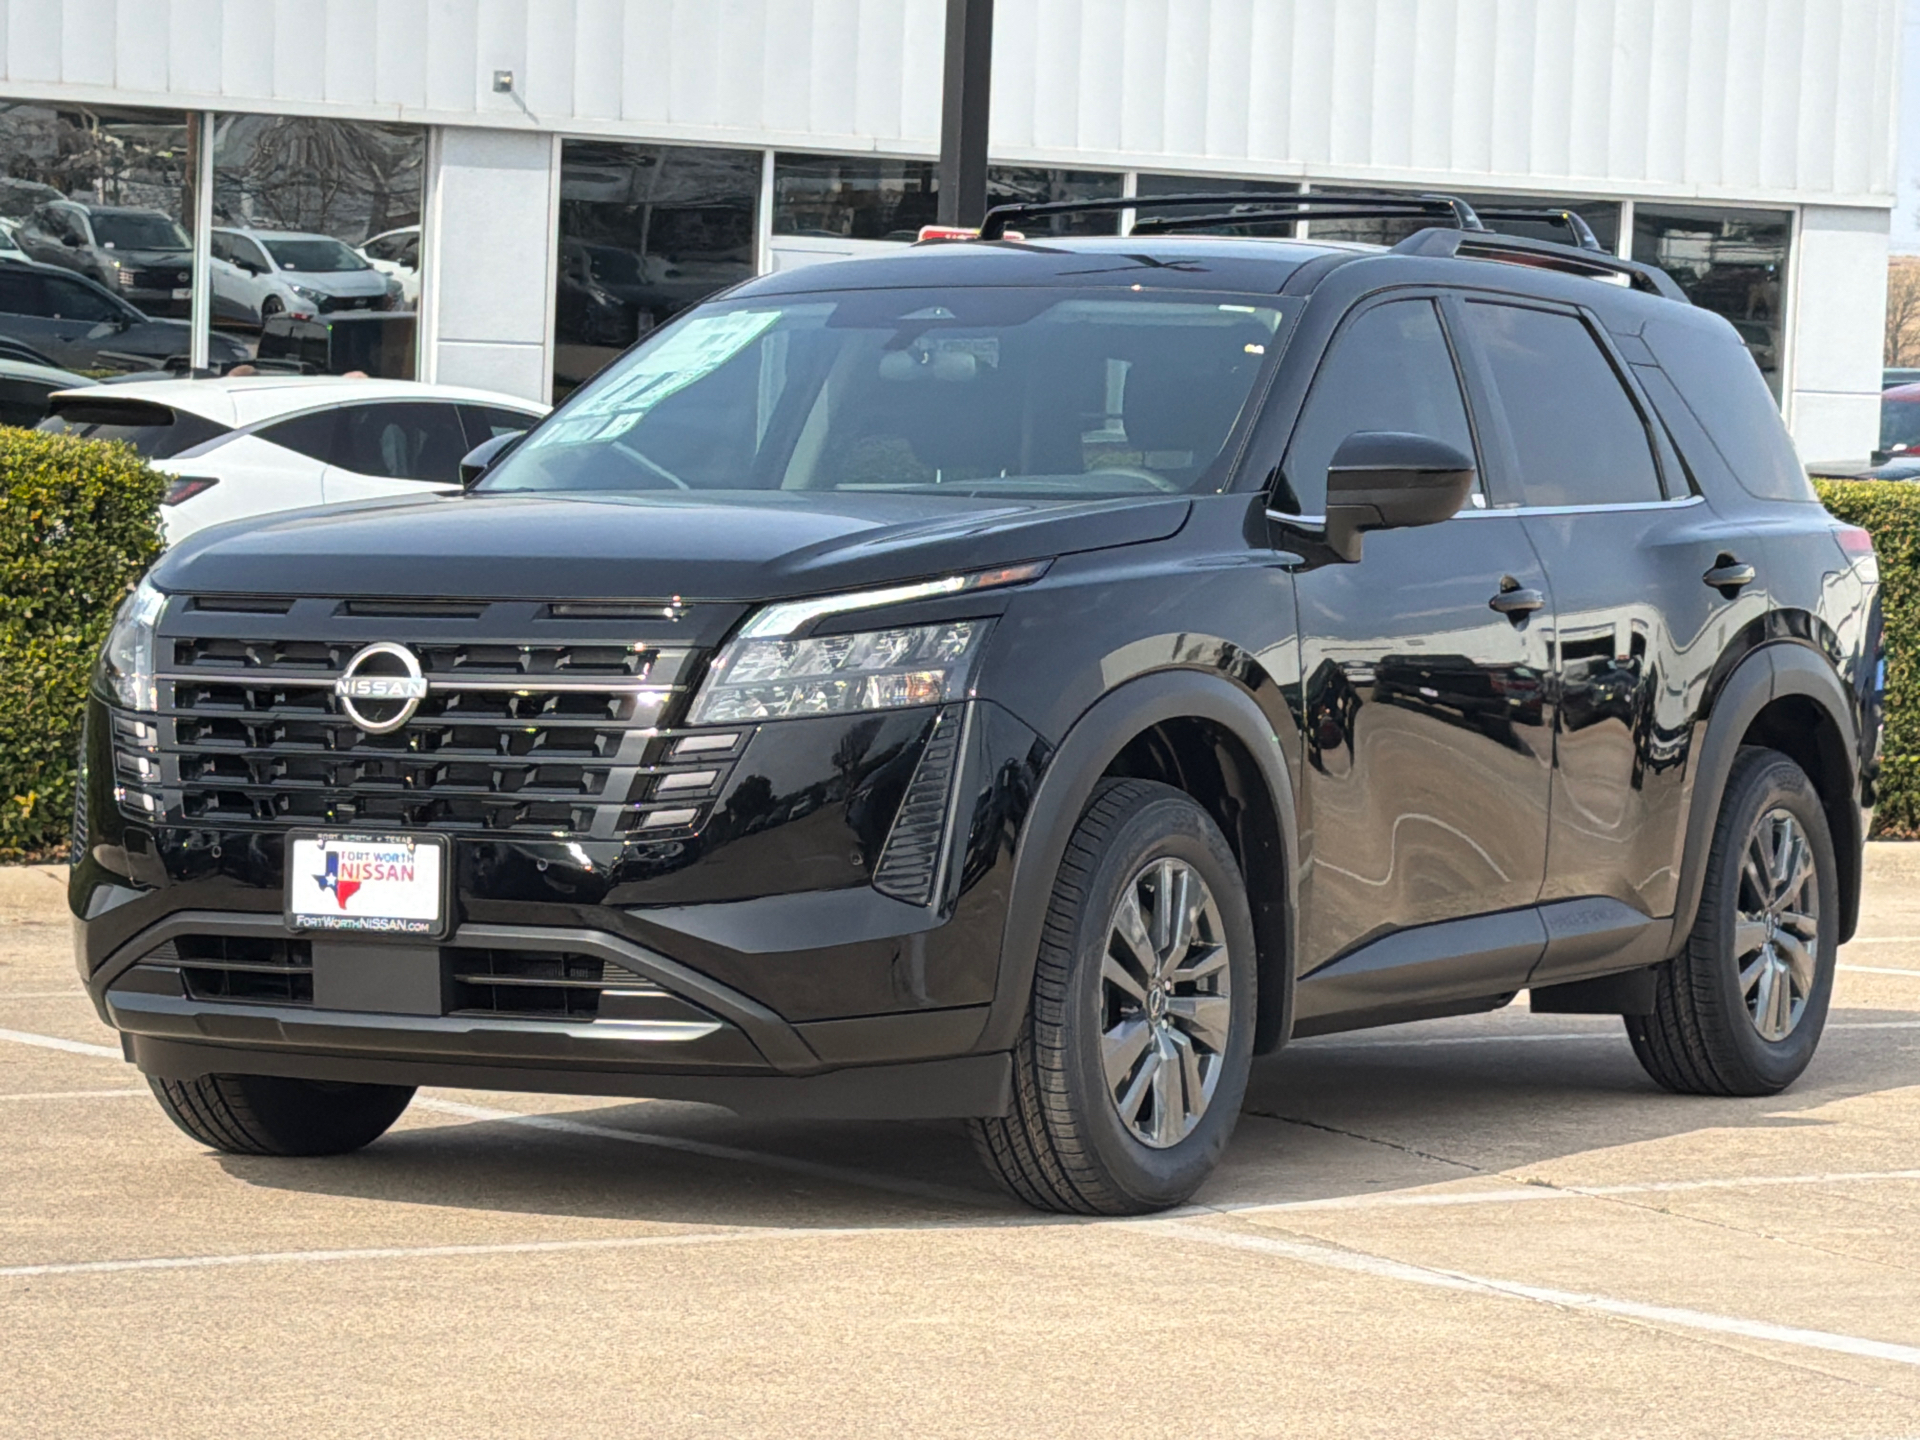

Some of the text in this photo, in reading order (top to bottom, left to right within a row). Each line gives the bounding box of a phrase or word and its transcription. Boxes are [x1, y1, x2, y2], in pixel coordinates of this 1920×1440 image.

[336, 680, 424, 696] NISSAN
[341, 851, 415, 864] FORT WORTH
[341, 862, 415, 882] NISSAN
